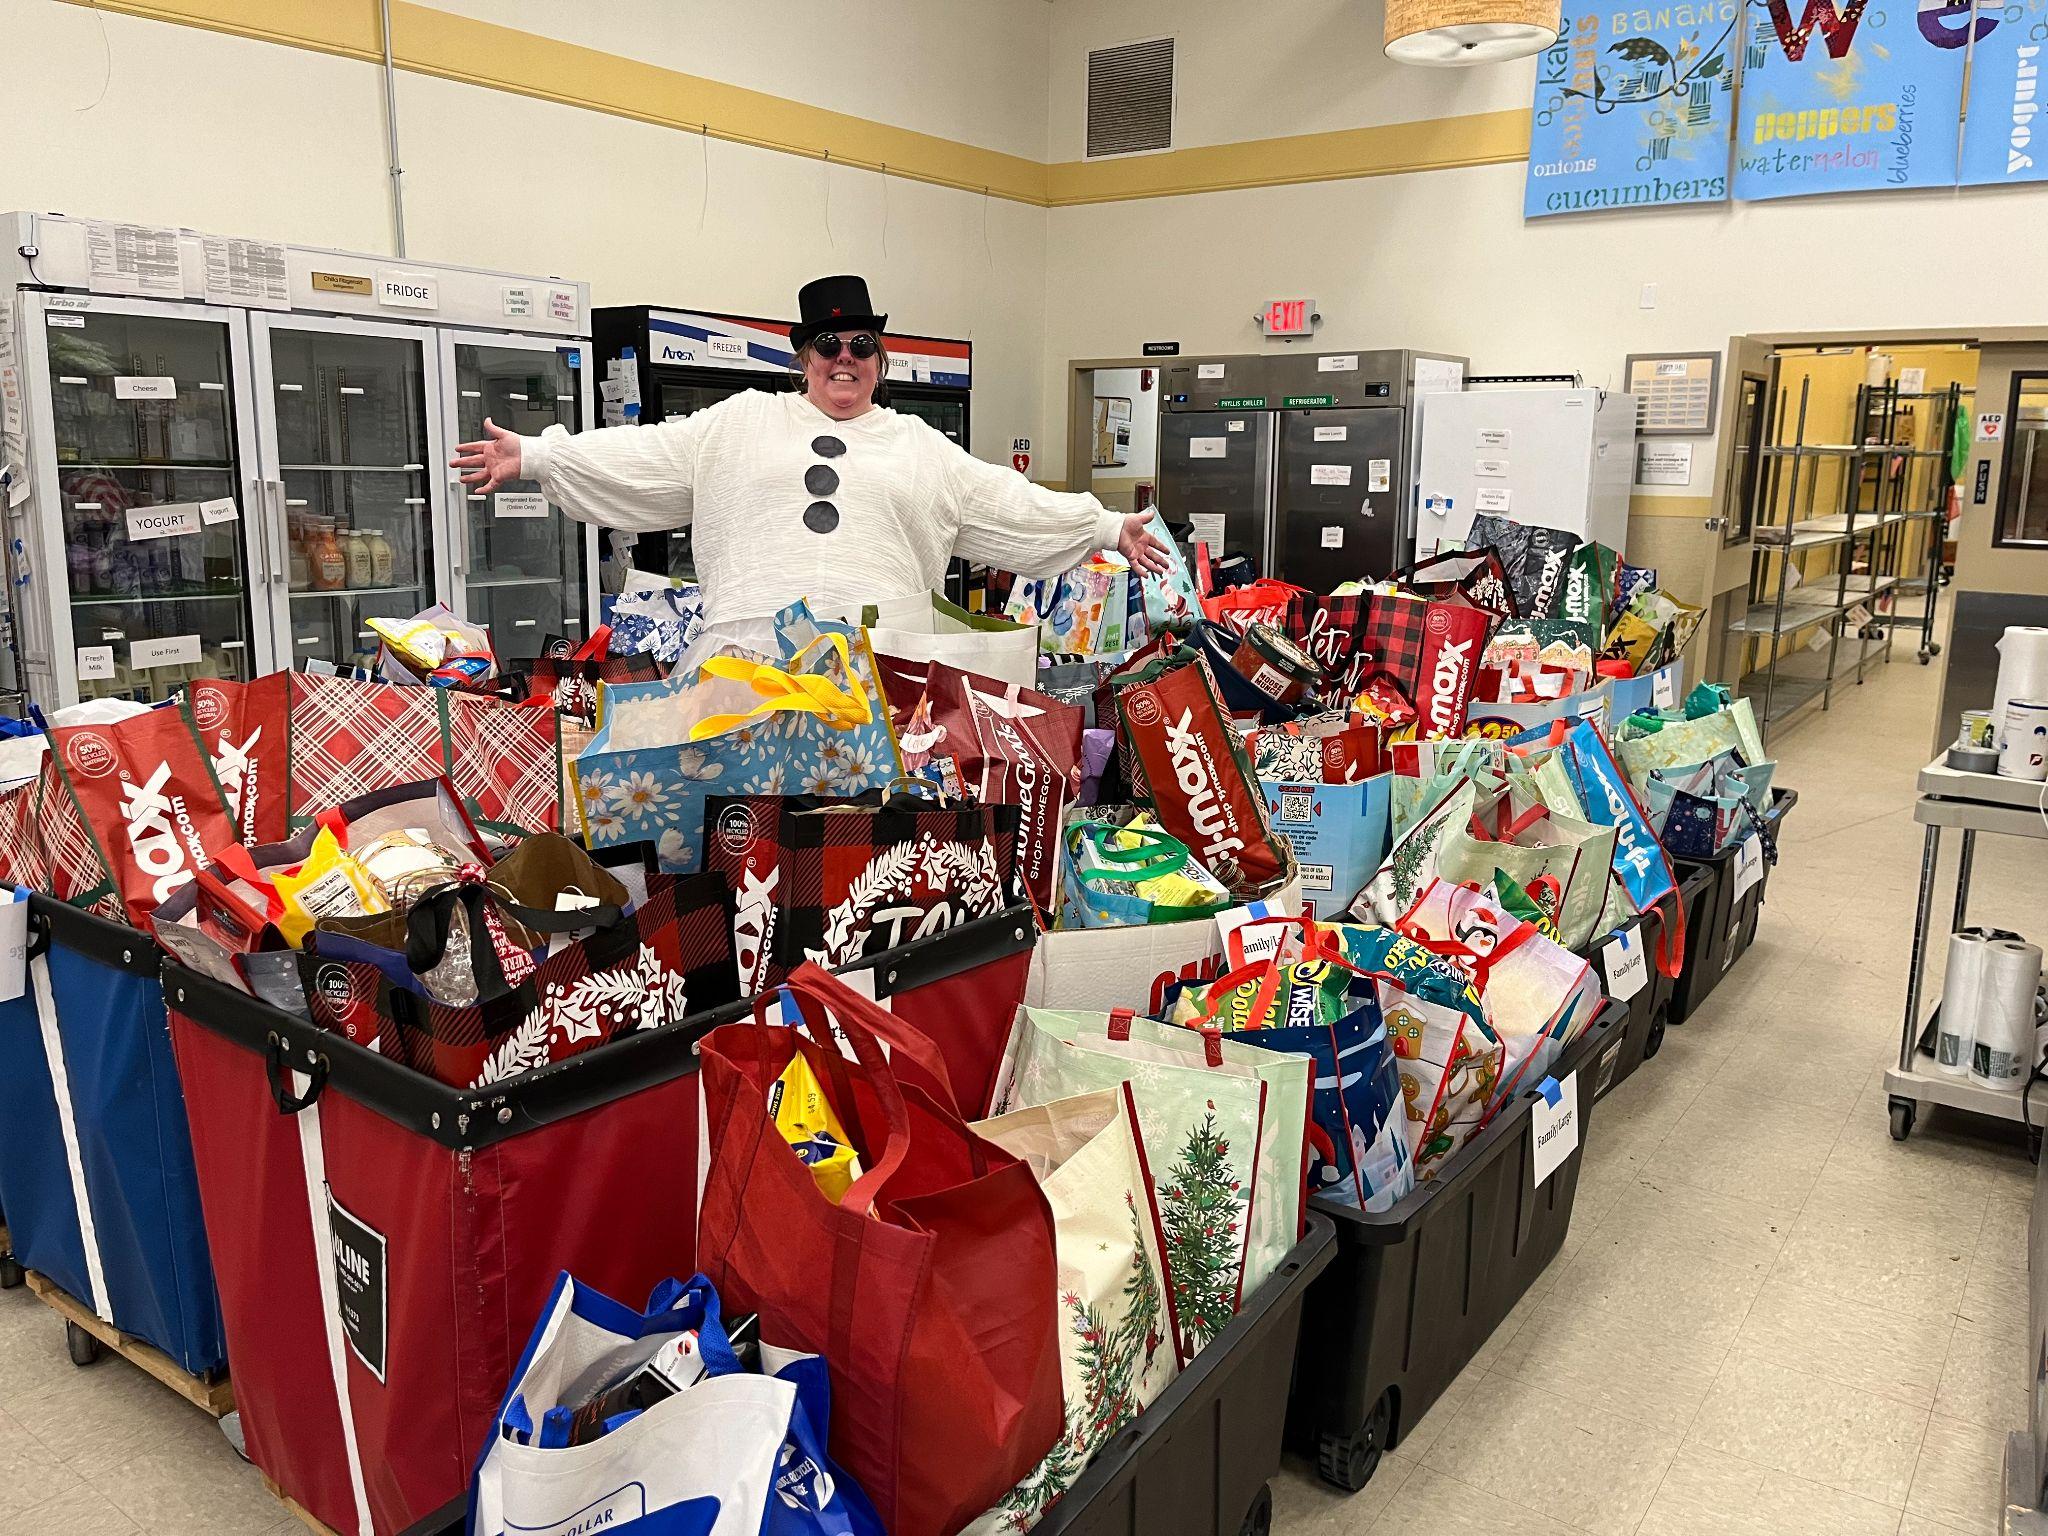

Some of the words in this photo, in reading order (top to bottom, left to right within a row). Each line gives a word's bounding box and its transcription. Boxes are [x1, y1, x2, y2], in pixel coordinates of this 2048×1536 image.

[2007, 45, 2039, 174] yogurt
[1754, 103, 1896, 144] peppers
[1887, 84, 1916, 184] blueberries
[1534, 158, 1597, 177] onions
[1739, 144, 1880, 175] watermelon
[1547, 176, 1726, 211] cucumbers
[386, 283, 429, 300] FRIDGE
[1271, 301, 1306, 331] EXIT
[713, 342, 742, 353] FREEZER
[889, 358, 909, 367] REEZER
[1289, 397, 1327, 405] REFRIGERATOR
[1981, 415, 2001, 423] AED
[1013, 438, 1030, 450] AED
[1976, 463, 1988, 500] PUSH
[209, 507, 229, 516] Yogurt
[136, 514, 185, 530] YOGURT
[151, 649, 164, 657] Use
[1255, 678, 1279, 697] MUNCH
[1259, 671, 1284, 691] MOOSE
[79, 743, 102, 755] 50%
[81, 750, 107, 761] RECYCLED
[83, 757, 108, 766] MATERIAL
[729, 820, 748, 828] 100%
[1223, 802, 1239, 833] shop
[1030, 843, 1043, 879] SHOP
[329, 980, 349, 989] 100%
[1290, 986, 1312, 1027] WISE
[1537, 1110, 1573, 1149] Family/Large
